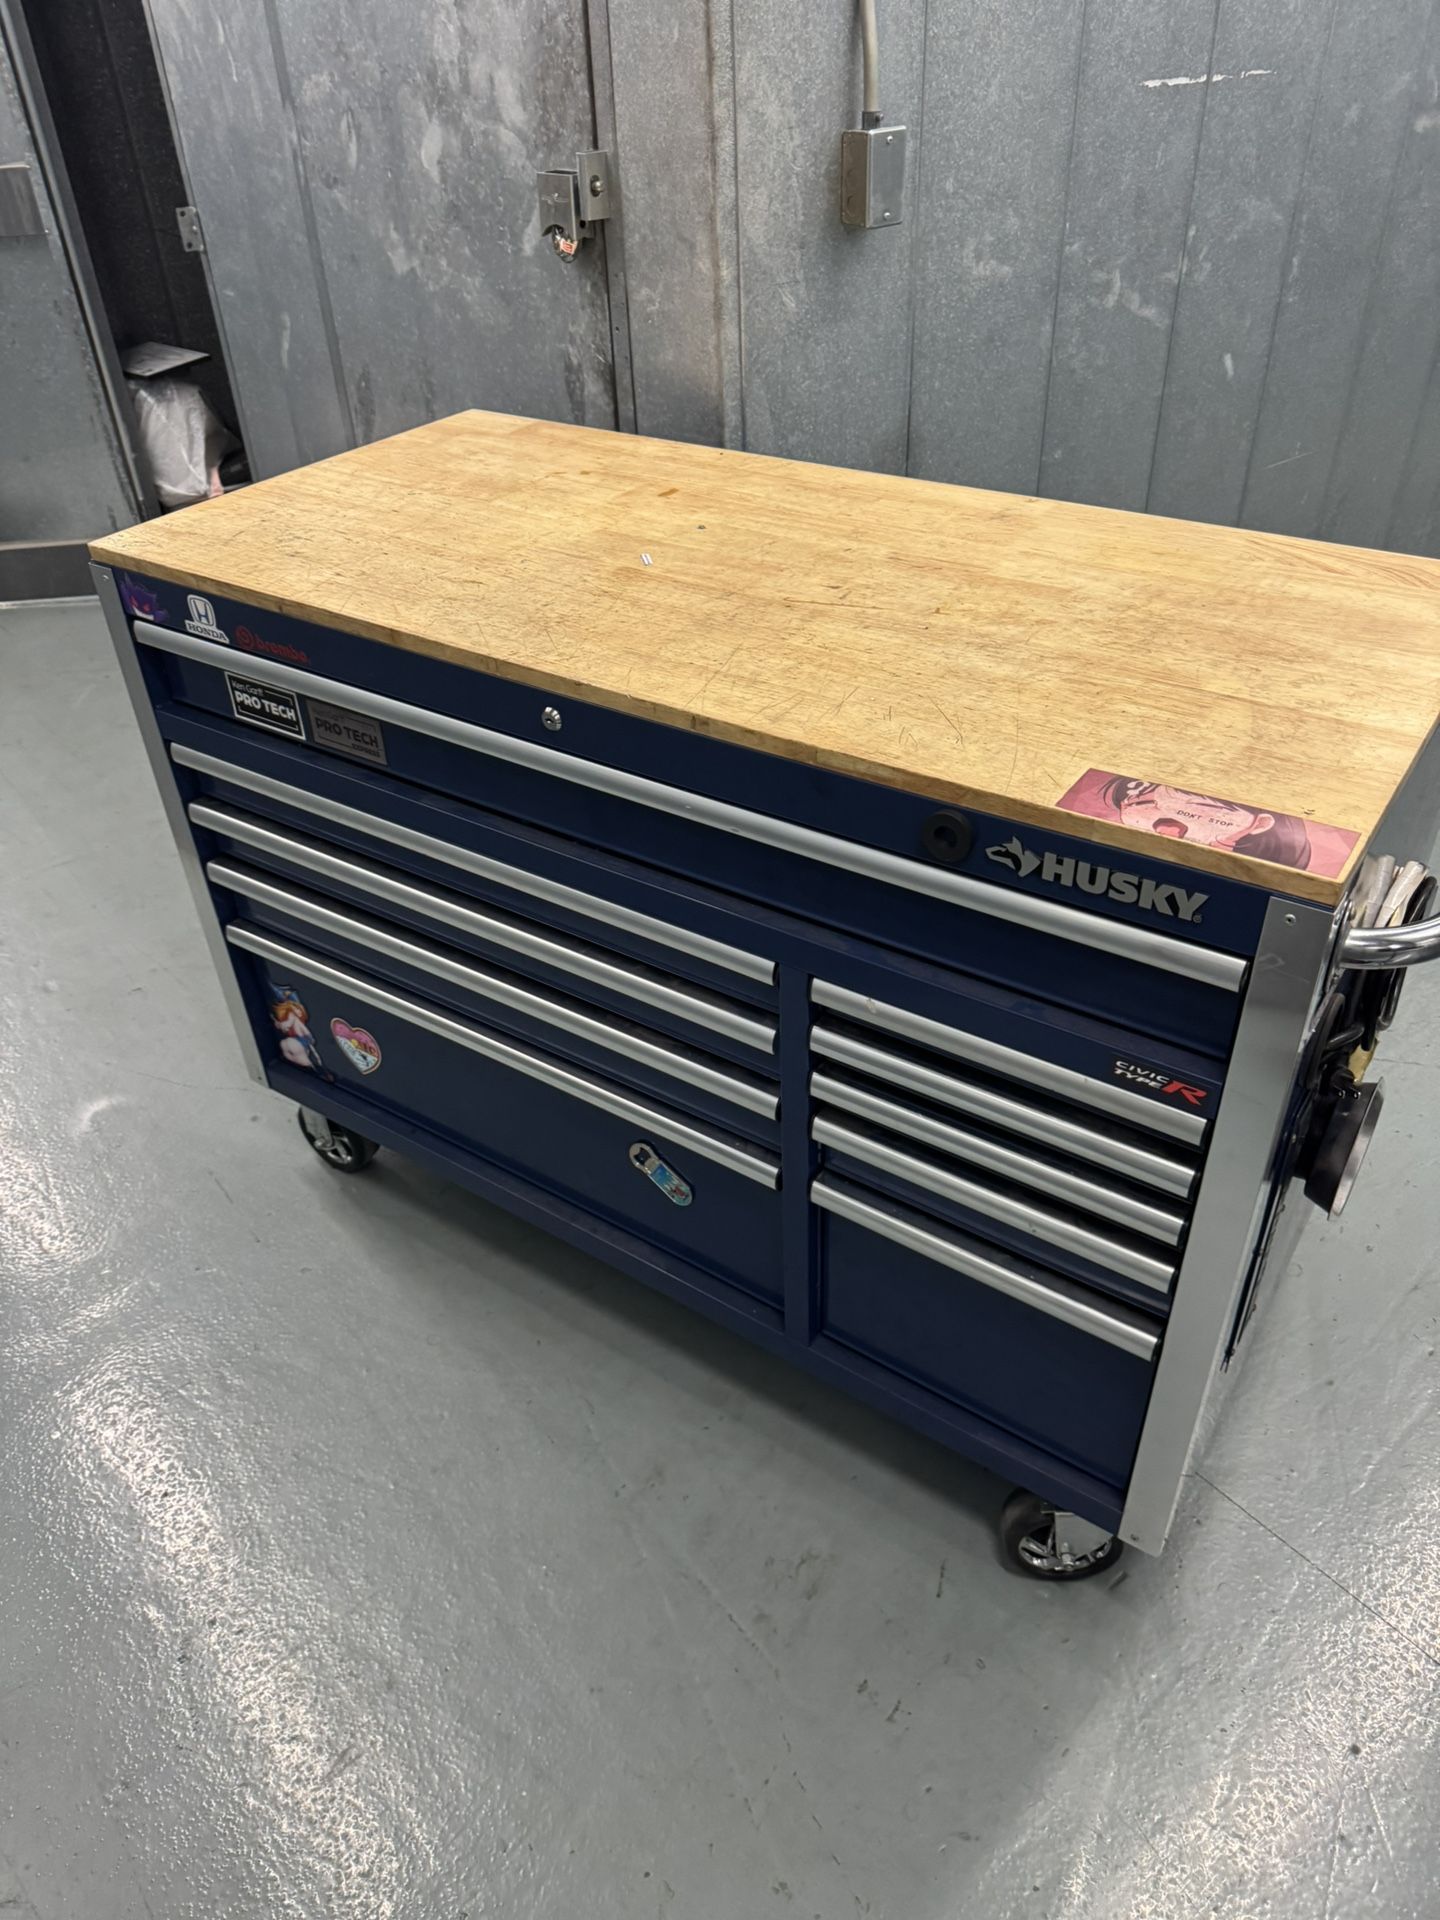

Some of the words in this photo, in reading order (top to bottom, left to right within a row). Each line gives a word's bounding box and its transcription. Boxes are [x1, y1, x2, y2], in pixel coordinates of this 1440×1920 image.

[187, 622, 228, 641] HONDA
[234, 690, 261, 709] PRO
[261, 699, 297, 722] TECH
[314, 716, 342, 736] PRO
[343, 726, 379, 749] TECH
[1208, 817, 1234, 827] STOP
[1041, 852, 1209, 922] HUSKY
[1114, 1067, 1164, 1090] TYPE
[1161, 1080, 1208, 1106] R
[1115, 1060, 1170, 1084] CIVIC
